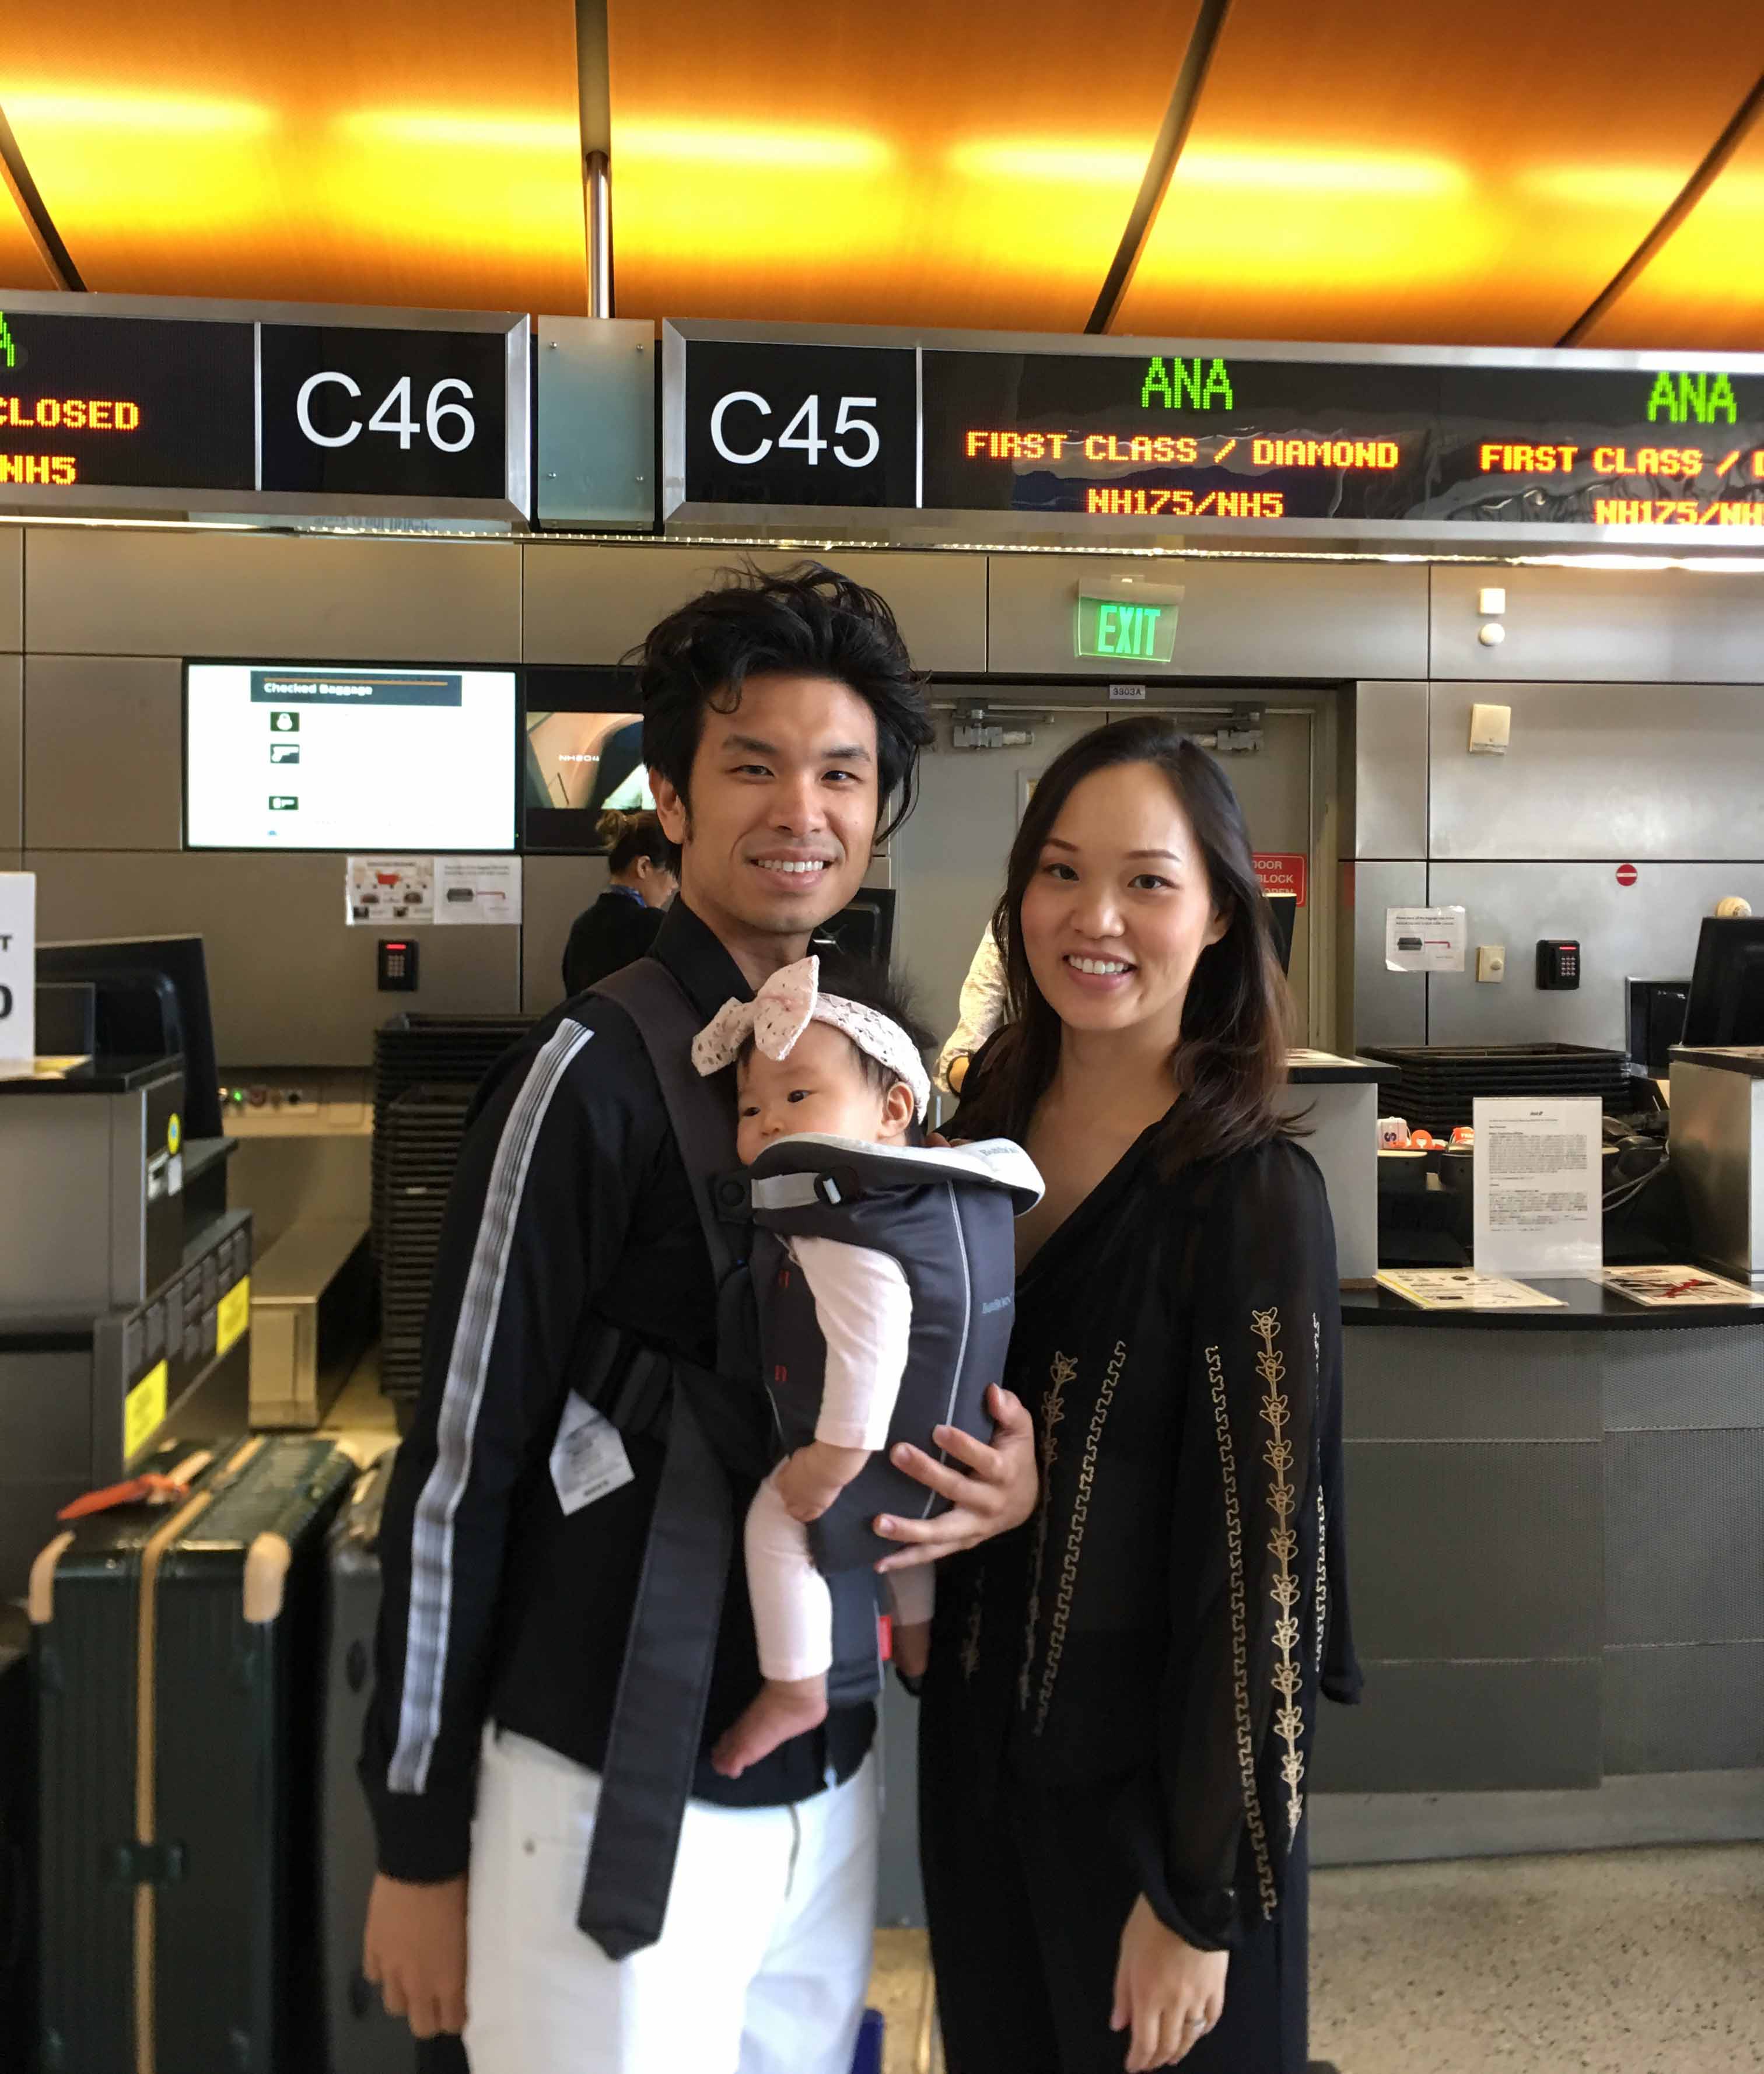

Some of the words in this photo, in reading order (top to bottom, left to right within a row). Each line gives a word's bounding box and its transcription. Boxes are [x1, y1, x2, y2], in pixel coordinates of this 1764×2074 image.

[1142, 356, 1233, 410] ANA
[1648, 371, 1737, 424] ANA
[296, 372, 475, 452] C46
[710, 391, 880, 467] C45
[966, 431, 1068, 460] FIRST
[1084, 435, 1198, 464] CLASS
[1252, 439, 1399, 469] DIAMOND
[1480, 444, 1578, 474] FIRST
[1592, 447, 1703, 478] CLASS
[1087, 489, 1283, 518] NH175/NH5
[1097, 605, 1161, 656] EXIT
[264, 682, 317, 694] Checked
[319, 684, 373, 696] Baggage
[1112, 687, 1142, 696] 3303A
